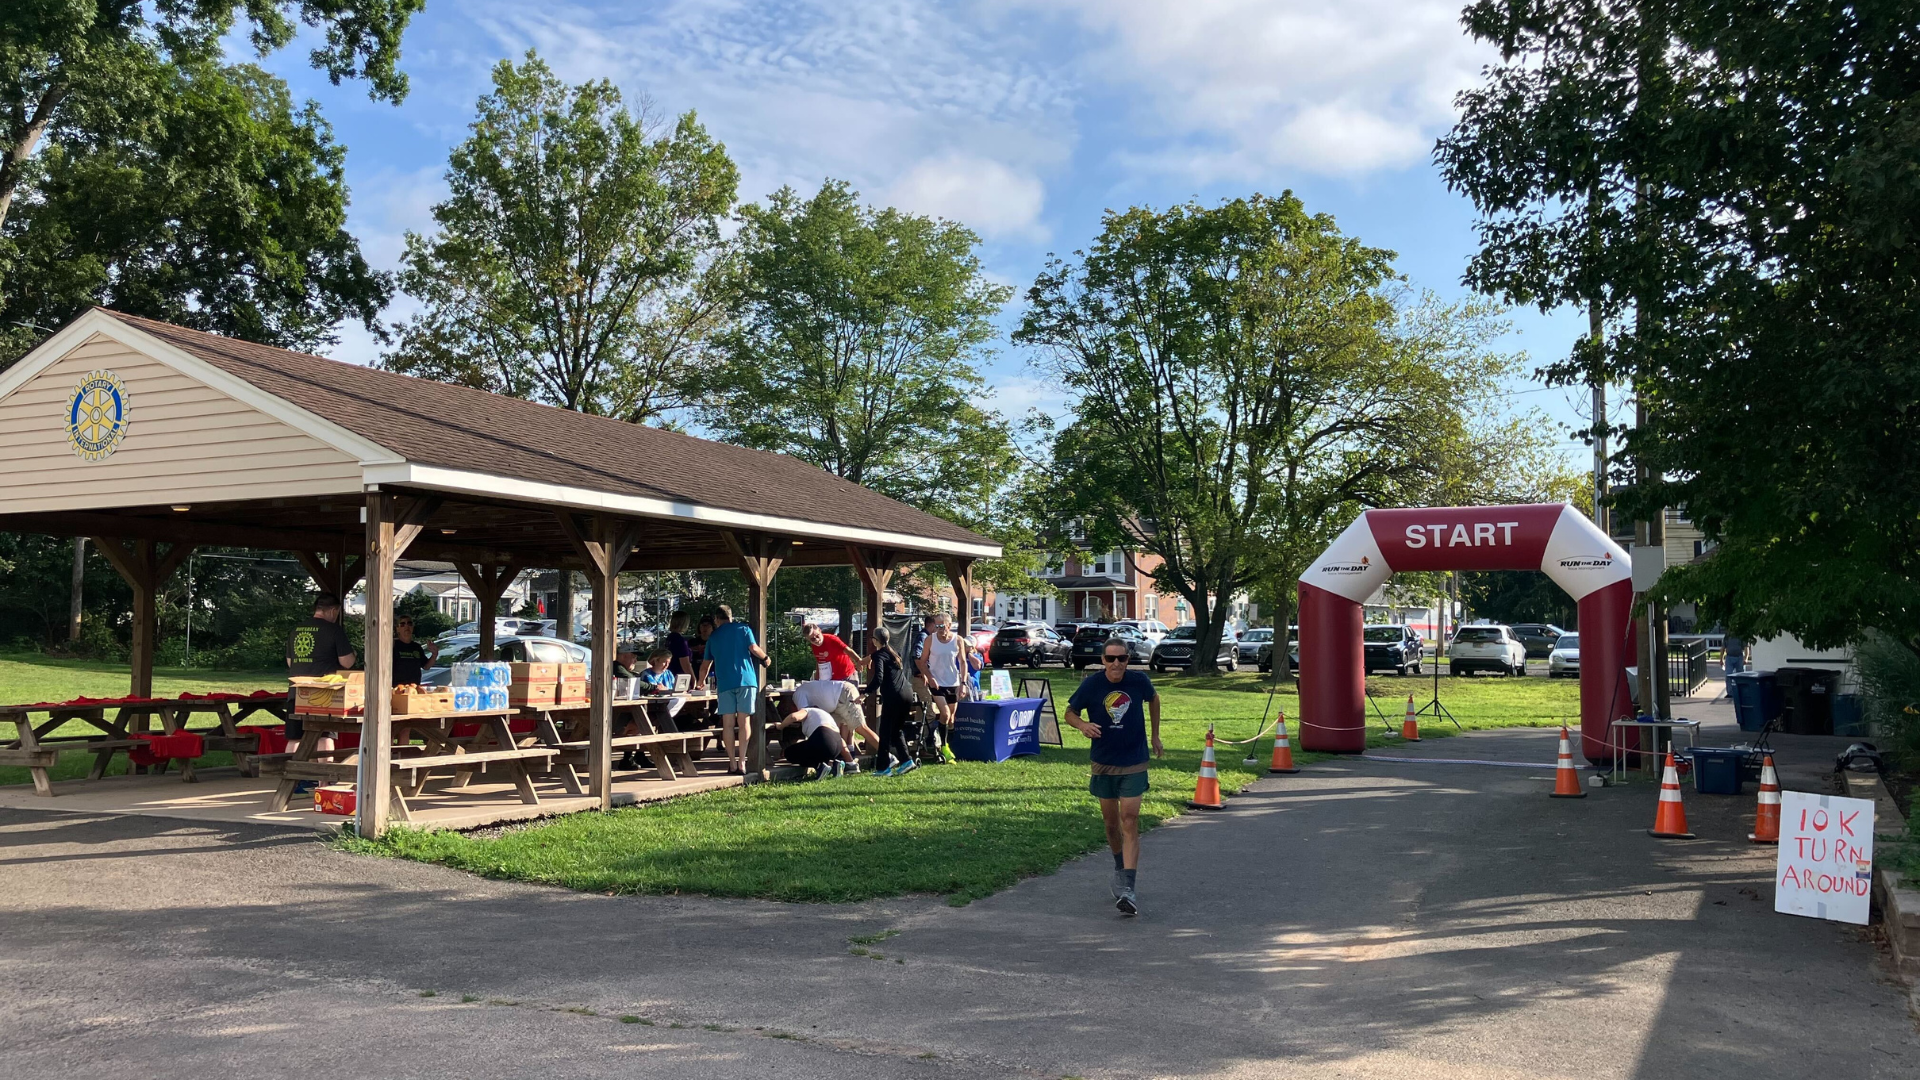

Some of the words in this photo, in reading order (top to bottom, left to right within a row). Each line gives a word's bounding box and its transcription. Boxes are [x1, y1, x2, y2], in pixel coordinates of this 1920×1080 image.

[84, 380, 112, 393] ROTARY
[73, 427, 119, 451] INTERNATIONAL
[1405, 522, 1519, 548] START
[1794, 837, 1863, 863] TURN
[1781, 864, 1868, 896] AROUND
